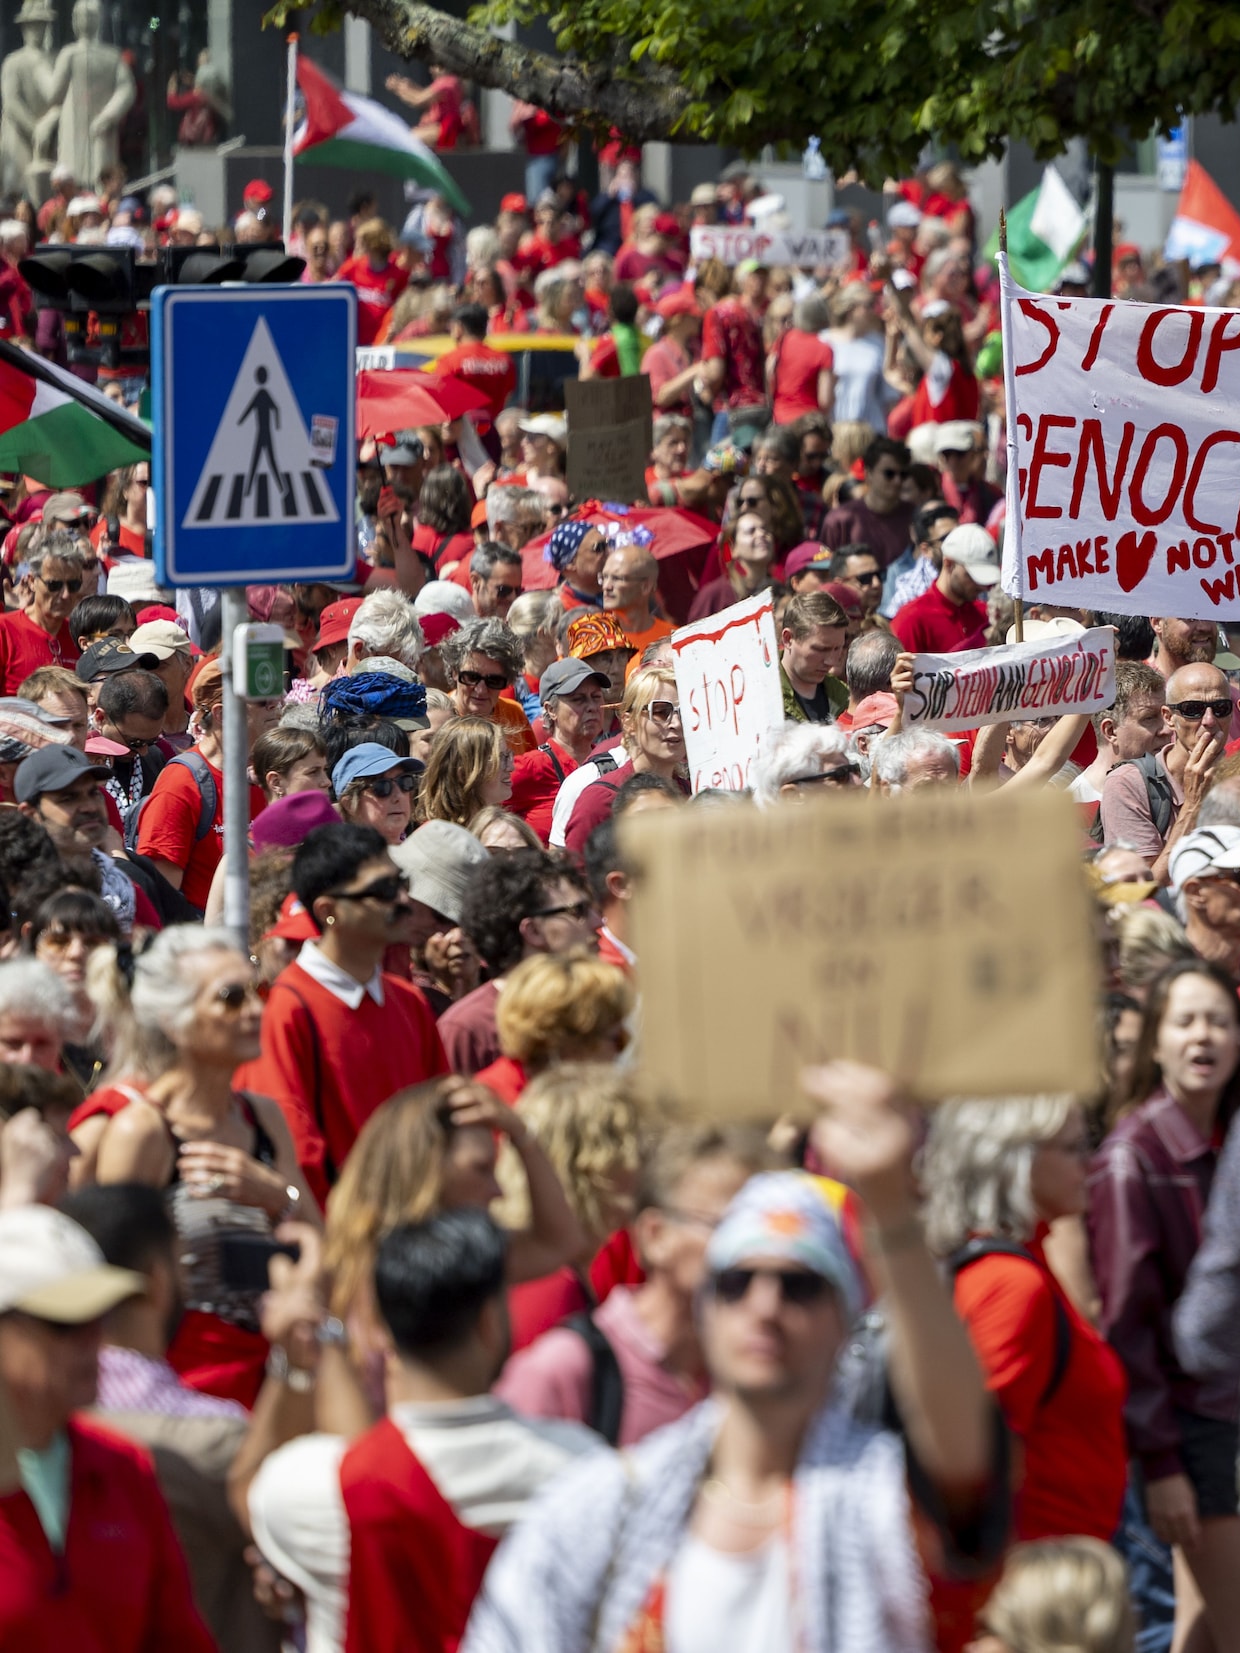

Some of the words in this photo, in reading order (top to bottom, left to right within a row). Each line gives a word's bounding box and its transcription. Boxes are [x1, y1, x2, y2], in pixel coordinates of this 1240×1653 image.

[701, 234, 772, 260] STOP
[785, 236, 839, 257] WAR
[1027, 535, 1110, 591] MAKE
[1166, 533, 1236, 575] NOT
